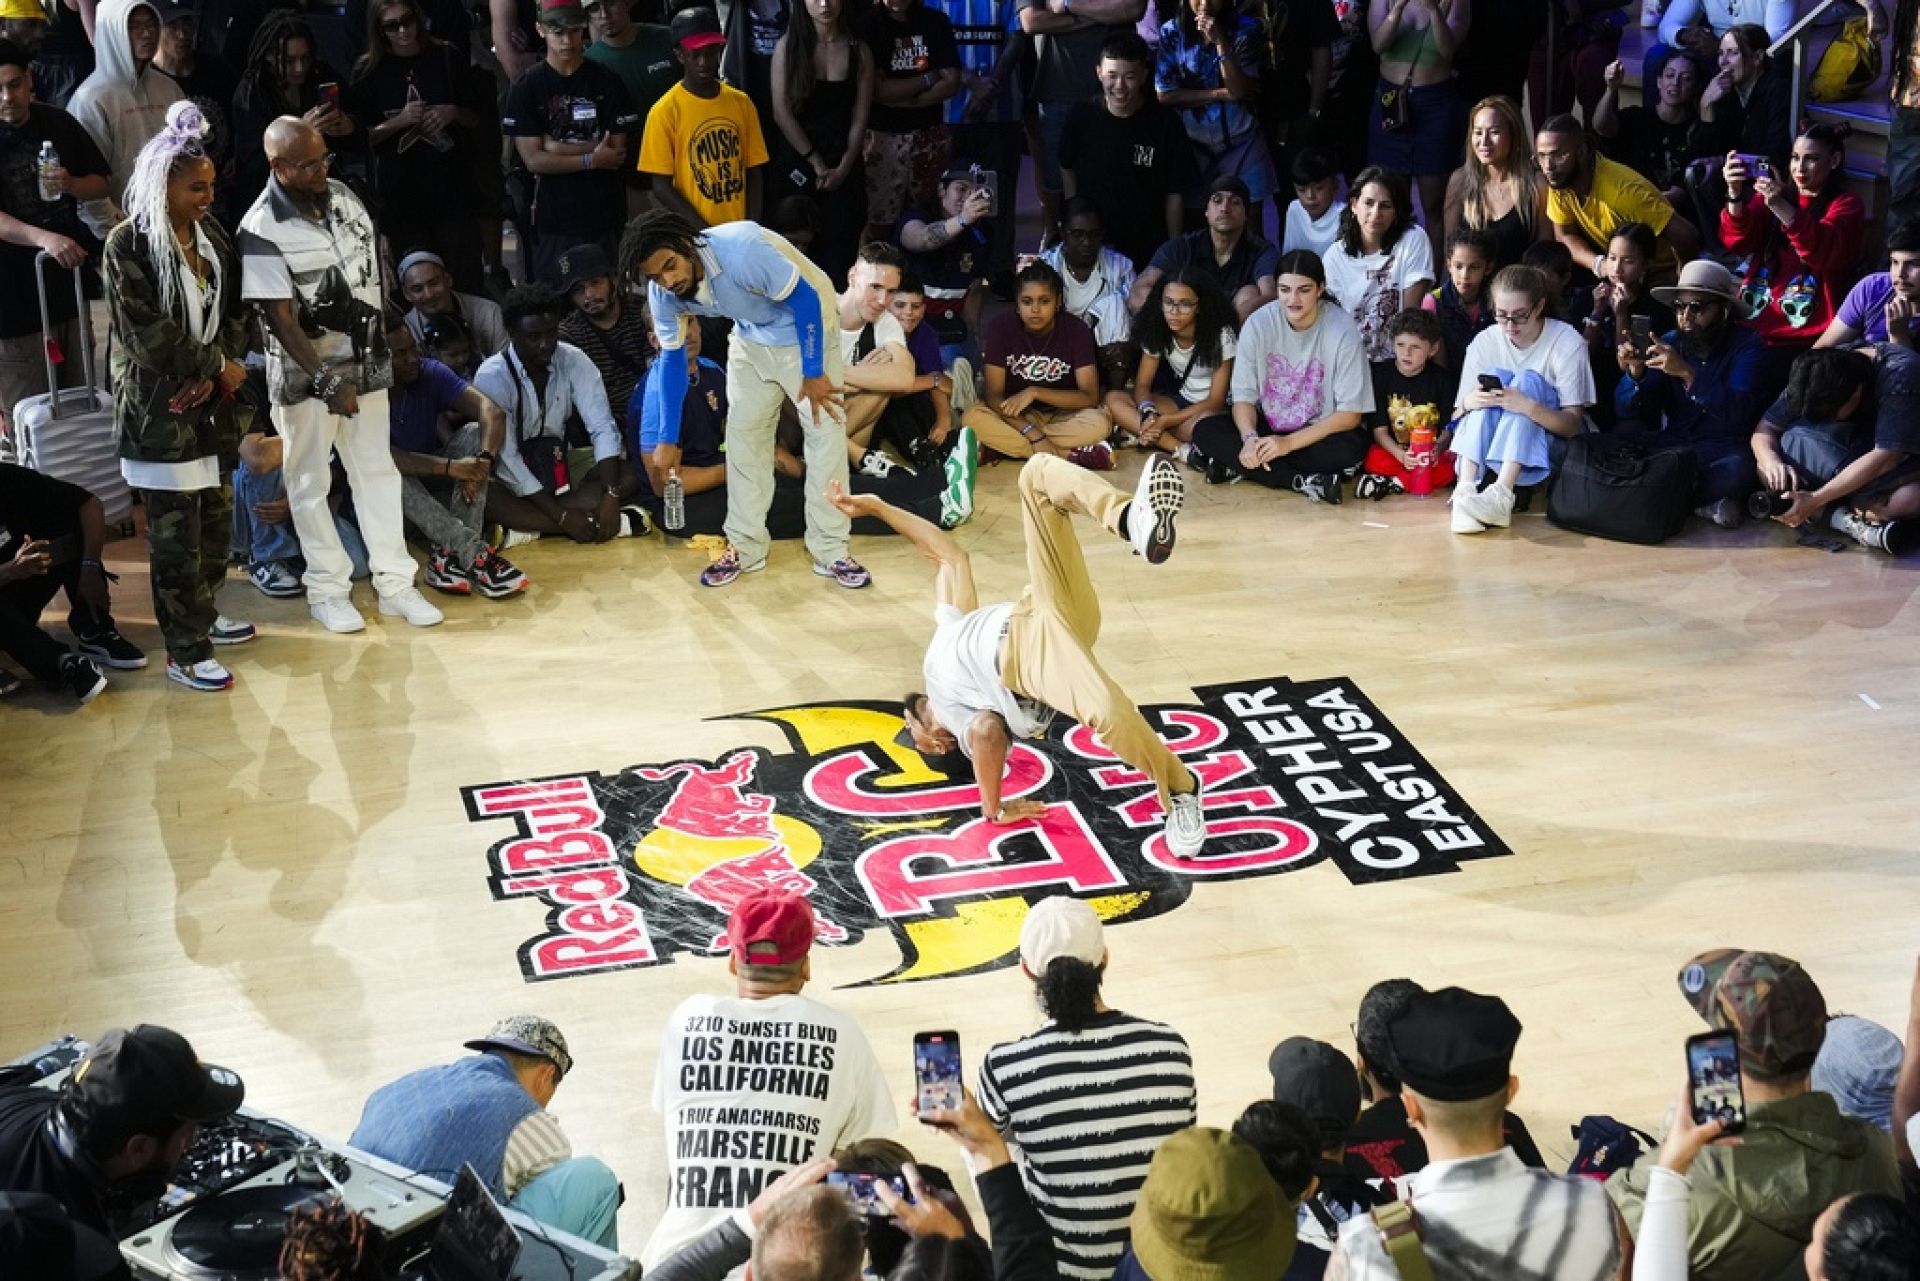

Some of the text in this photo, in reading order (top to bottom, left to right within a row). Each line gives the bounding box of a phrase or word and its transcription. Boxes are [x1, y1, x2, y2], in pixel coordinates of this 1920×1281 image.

[1221, 685, 1421, 869] CYPHER
[1306, 686, 1486, 854] EAST USA
[685, 1016, 837, 1044] 3210 SUNSET BLVD
[682, 1036, 835, 1071] LOS ANGELES
[680, 1064, 830, 1101] CALIFORNIA
[687, 1107, 715, 1124] RUE
[715, 1107, 821, 1135] ANACHARSIS
[676, 1129, 816, 1165] MARSEILLE
[676, 1166, 788, 1208] FRAN
